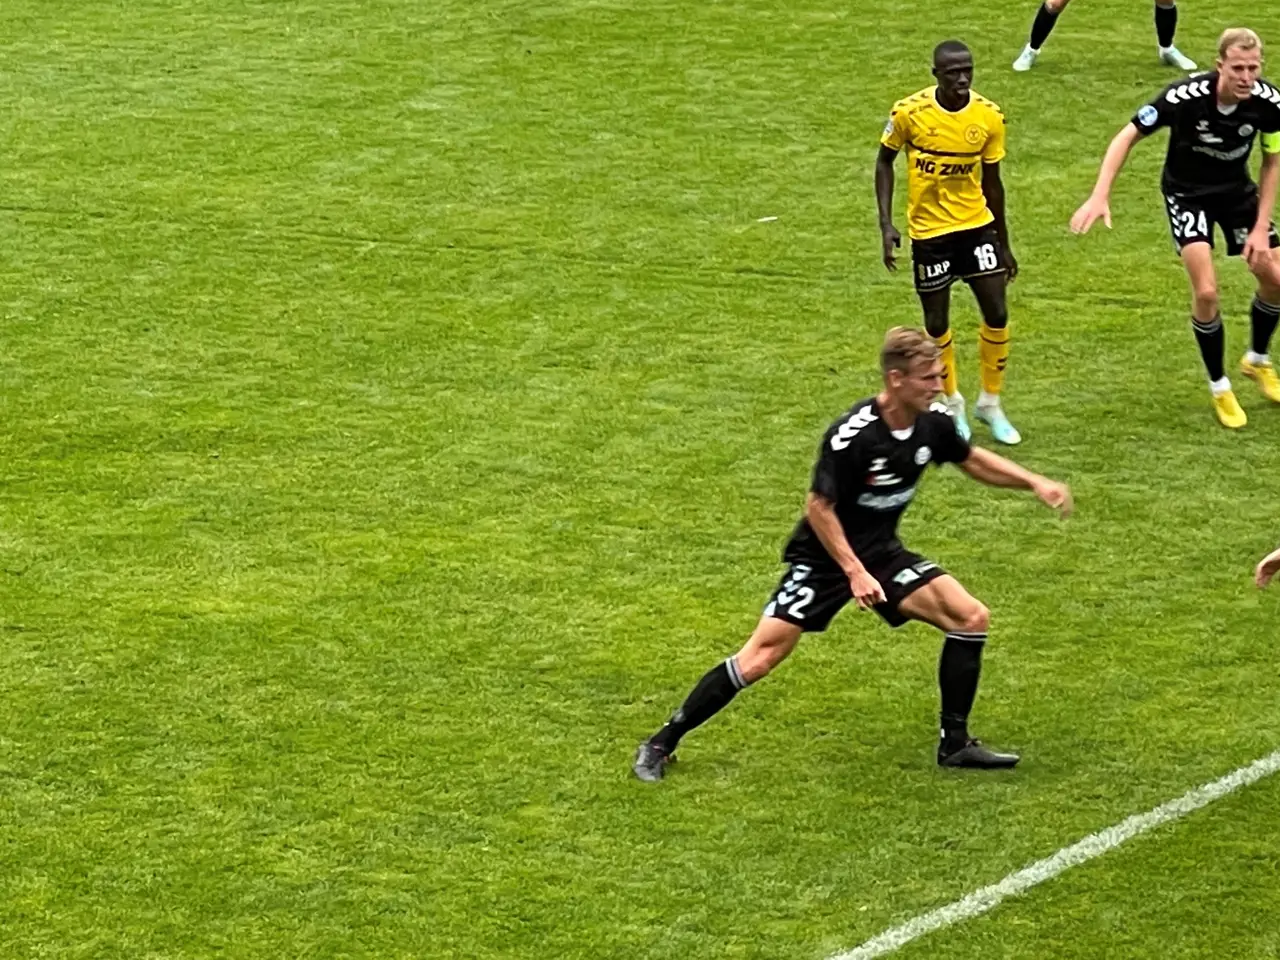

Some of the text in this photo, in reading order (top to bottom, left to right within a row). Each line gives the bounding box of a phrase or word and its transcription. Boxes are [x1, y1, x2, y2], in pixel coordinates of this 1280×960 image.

[915, 158, 976, 176] NG ZINK
[1181, 210, 1208, 238] 24
[926, 260, 951, 279] LRP
[973, 243, 998, 272] 16
[788, 586, 815, 619] 2
